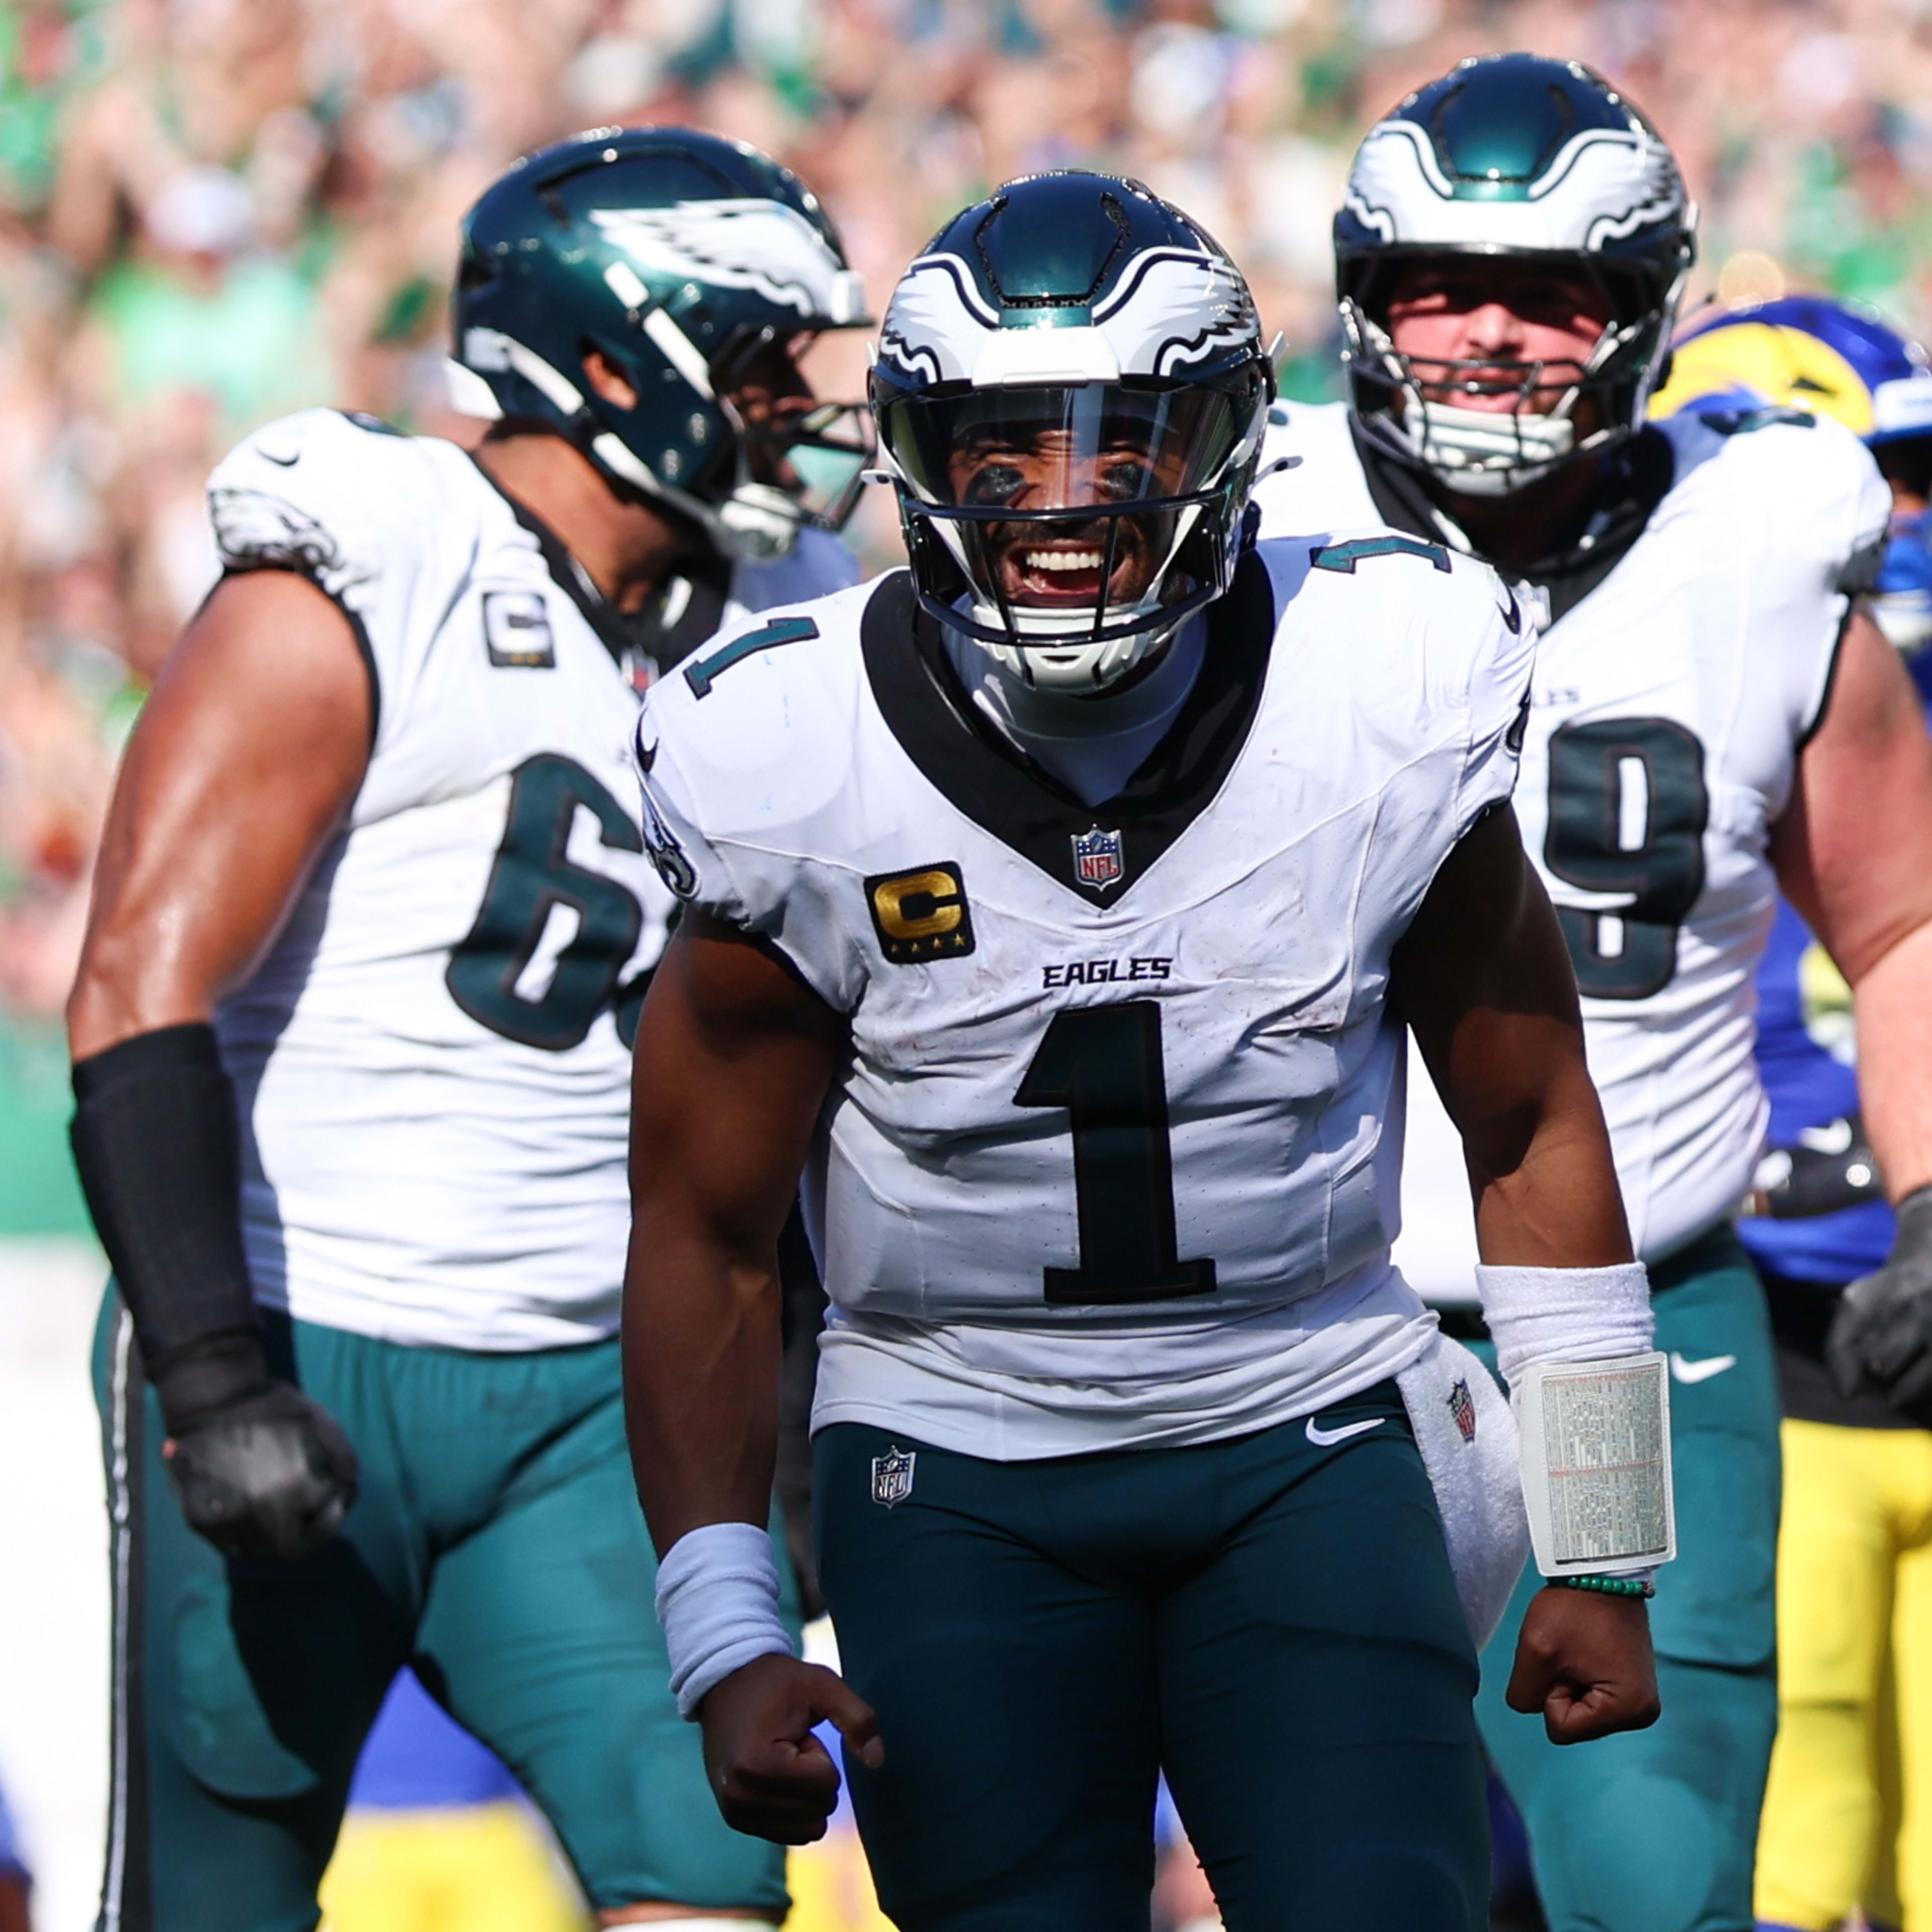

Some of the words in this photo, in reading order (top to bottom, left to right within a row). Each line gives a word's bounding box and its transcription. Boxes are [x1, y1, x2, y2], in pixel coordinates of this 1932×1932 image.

[486, 594, 550, 653] C
[682, 616, 819, 700] 1
[1082, 856, 1118, 879] NFL
[445, 752, 681, 1052] 6
[874, 871, 961, 939] C
[1042, 957, 1173, 989] EAGLES
[1012, 1000, 1217, 1306] 1
[877, 1473, 906, 1497] NFL
